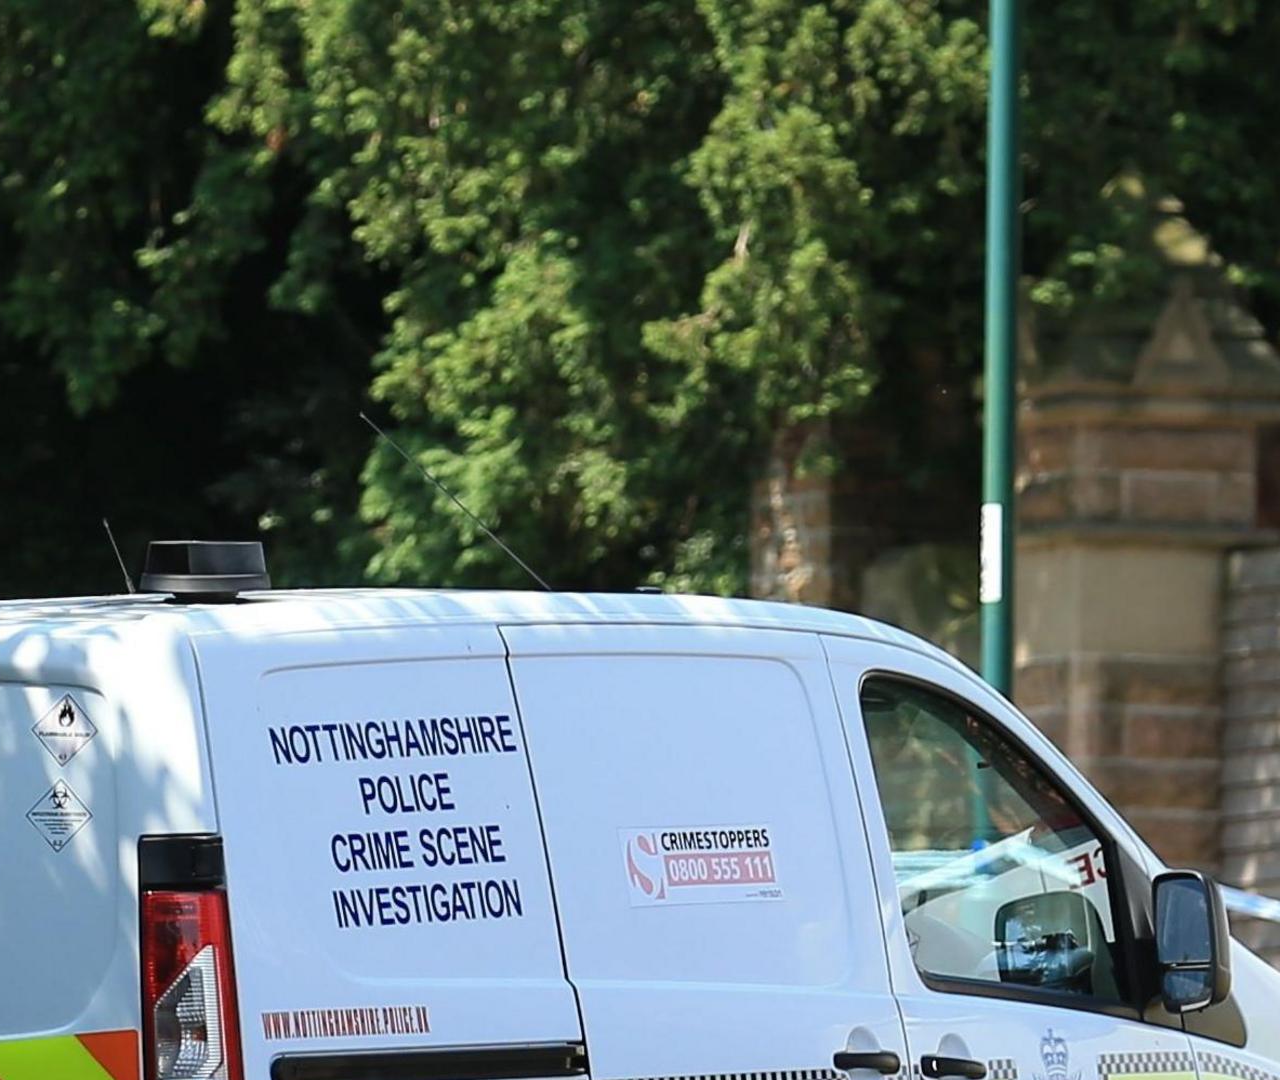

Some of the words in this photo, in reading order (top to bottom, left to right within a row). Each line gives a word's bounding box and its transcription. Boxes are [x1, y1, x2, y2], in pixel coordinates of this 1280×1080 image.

[268, 714, 518, 765] NOTTINGHAMSHIRE
[358, 772, 456, 815] POLICE
[331, 830, 415, 873] CRIME
[420, 825, 506, 868] SCENE
[661, 828, 770, 851] CRIMESTOPPERS
[669, 857, 708, 882] 0800
[711, 856, 741, 881] 555
[744, 855, 773, 880] 111
[332, 879, 523, 929] INVESTIGATION
[261, 1006, 430, 1040] WWW.NOTTINGHAMSHIRE.POLICE.UK
